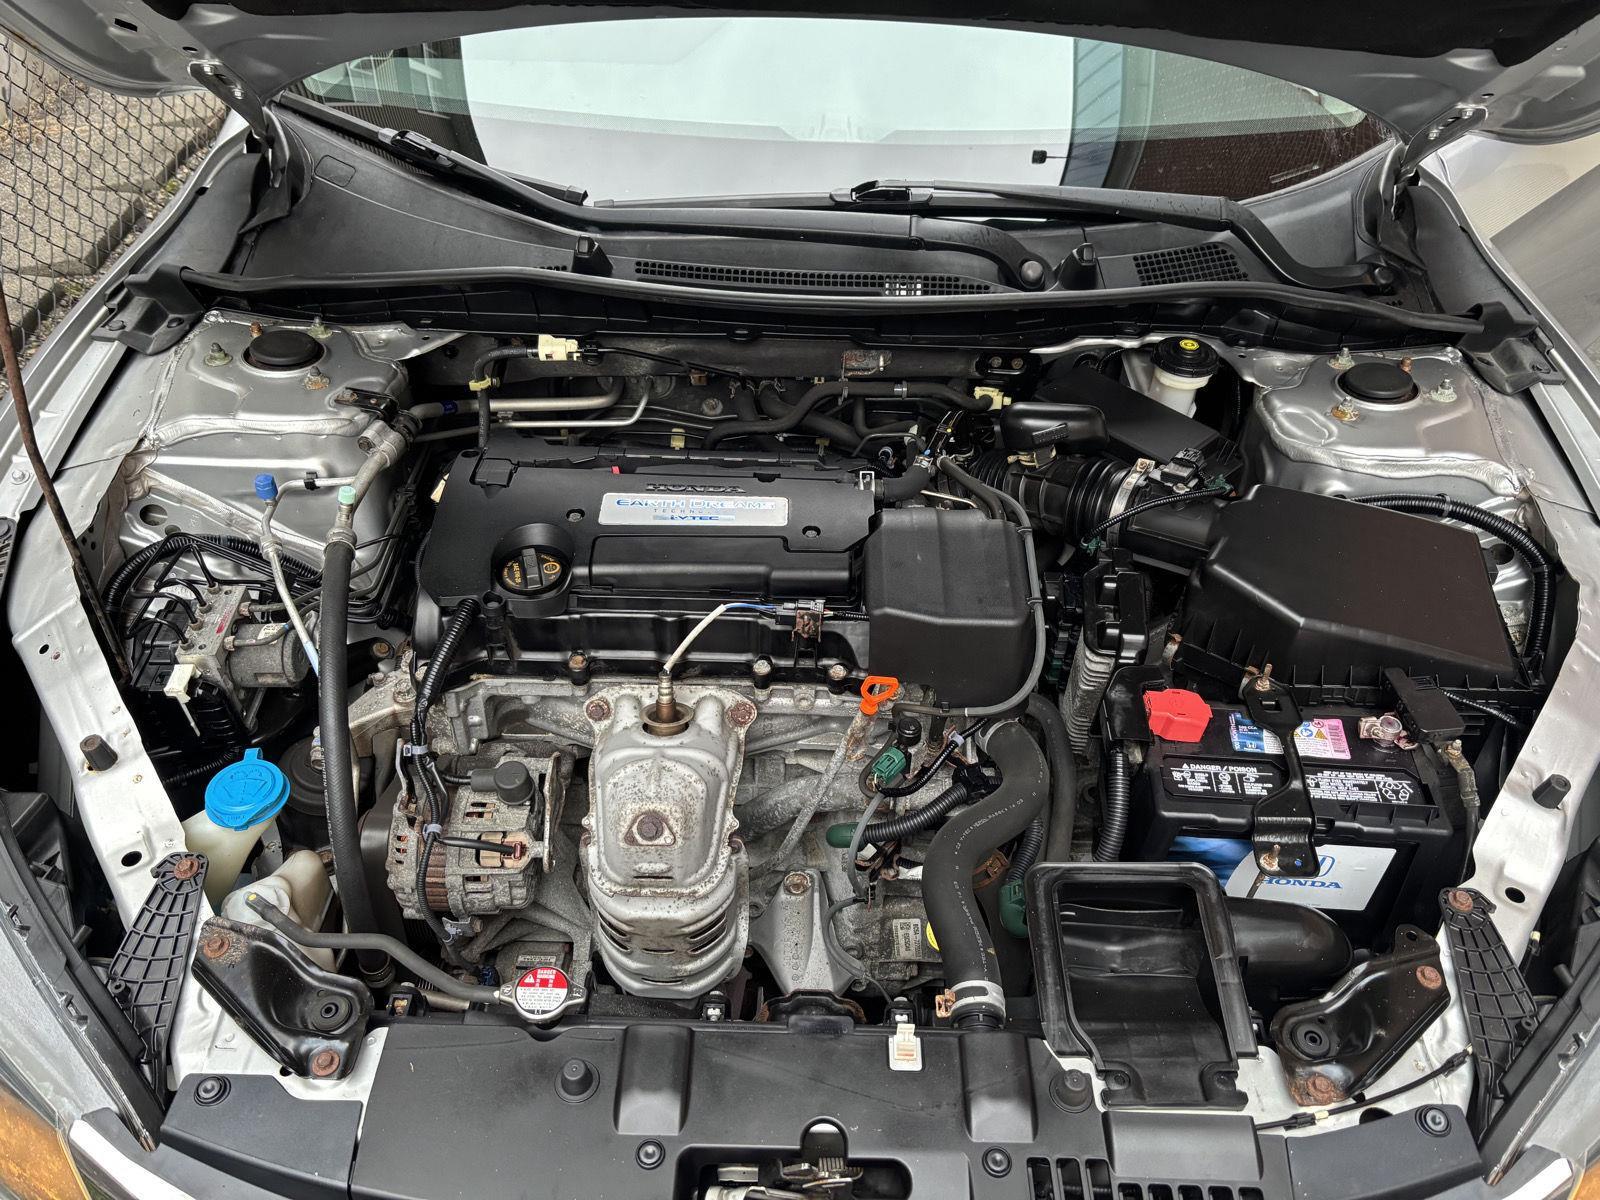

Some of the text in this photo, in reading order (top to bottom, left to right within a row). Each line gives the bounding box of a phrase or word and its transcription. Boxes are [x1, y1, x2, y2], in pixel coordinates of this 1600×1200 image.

[645, 483, 746, 493] HONDA
[616, 499, 686, 508] EARTH
[1190, 763, 1221, 771] DANGER
[1262, 877, 1342, 889] HONDA
